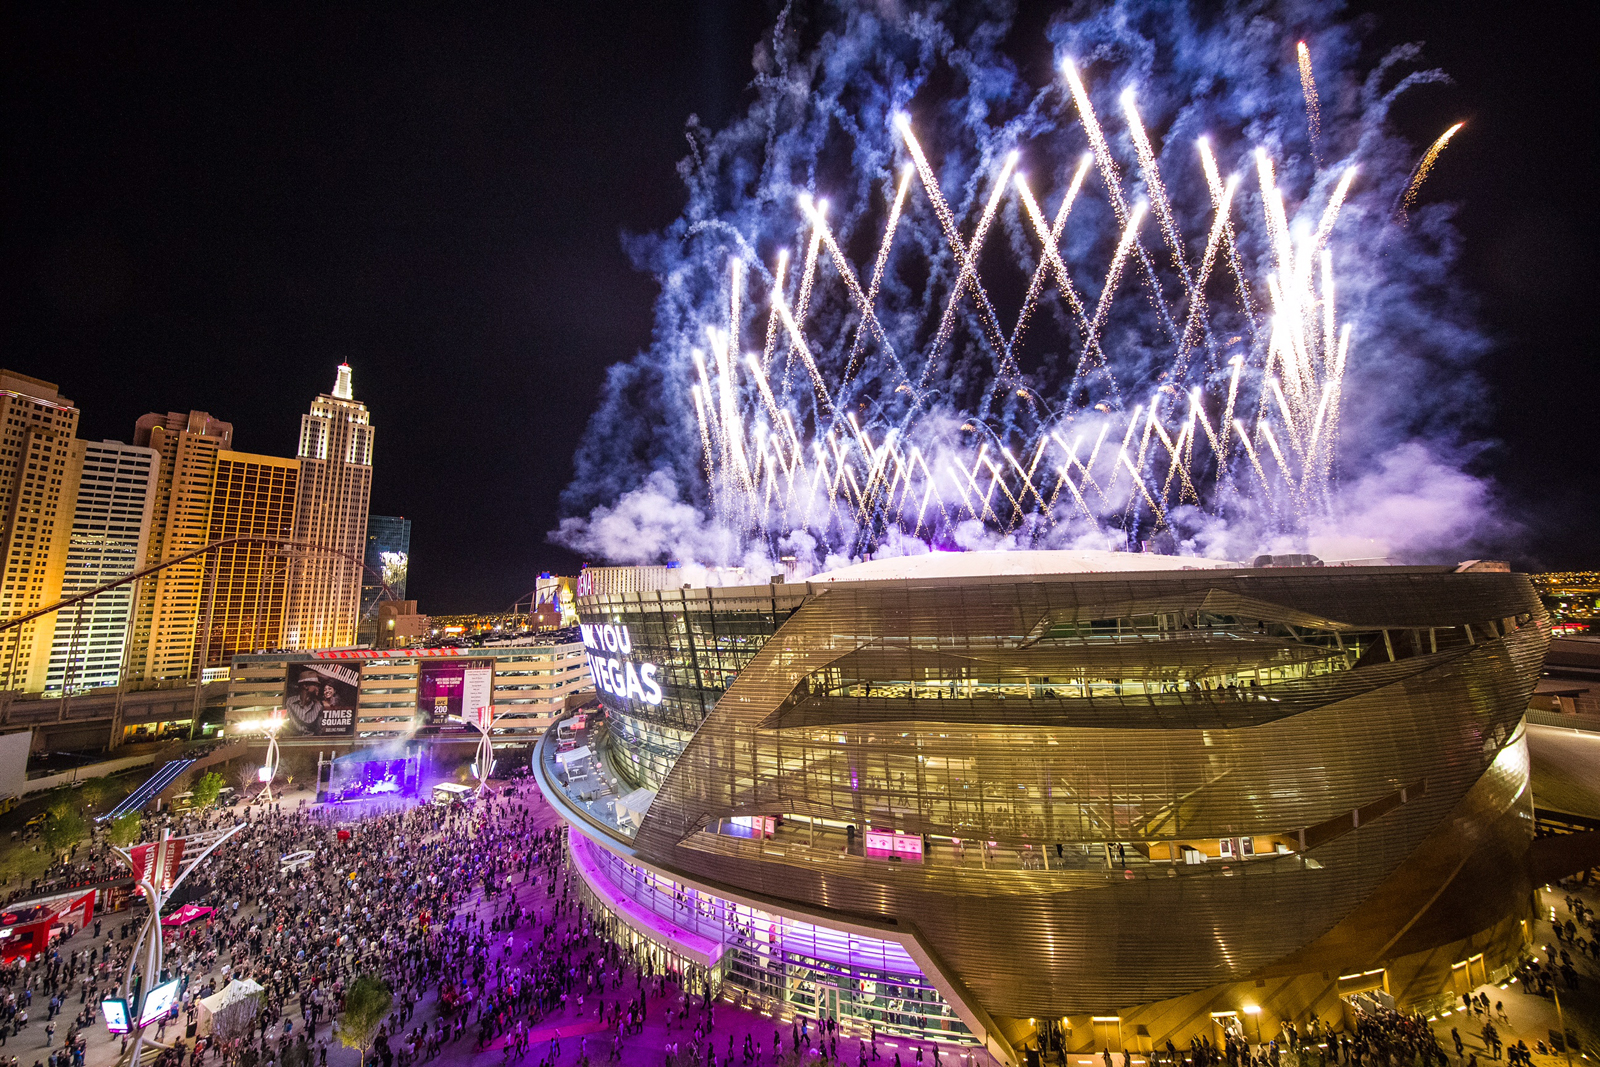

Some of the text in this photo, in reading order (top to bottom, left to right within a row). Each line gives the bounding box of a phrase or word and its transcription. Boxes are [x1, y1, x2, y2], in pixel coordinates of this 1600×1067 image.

[594, 624, 631, 653] YOU
[317, 649, 459, 659] TOSHIBA PLAZA
[590, 653, 662, 705] VEGAS
[322, 709, 353, 719] TIMES
[434, 705, 448, 713] 200
[321, 718, 352, 726] SQUARE
[143, 845, 155, 882] OSHIBA
[164, 842, 176, 884] TOSHIBA
